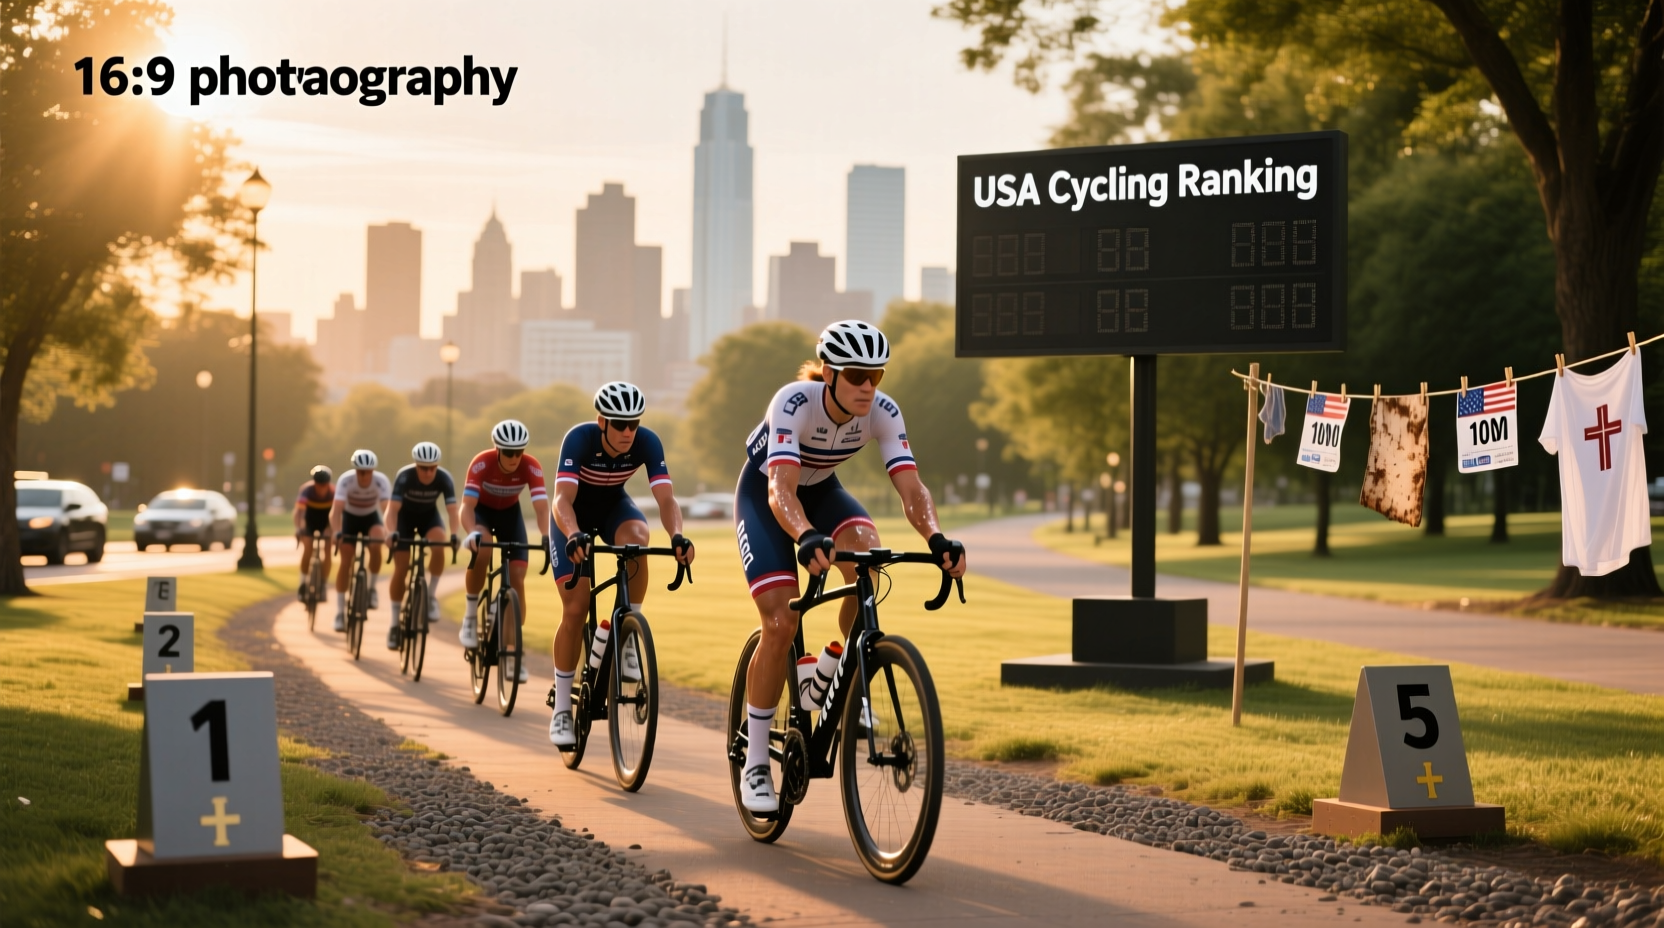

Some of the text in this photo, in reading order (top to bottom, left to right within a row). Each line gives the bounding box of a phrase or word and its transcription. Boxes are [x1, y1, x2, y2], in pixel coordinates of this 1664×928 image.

[973, 157, 1318, 212] USA Cycling Ranking
[158, 624, 180, 658] 2
[190, 699, 230, 782] 1
[1396, 683, 1440, 750] 5
